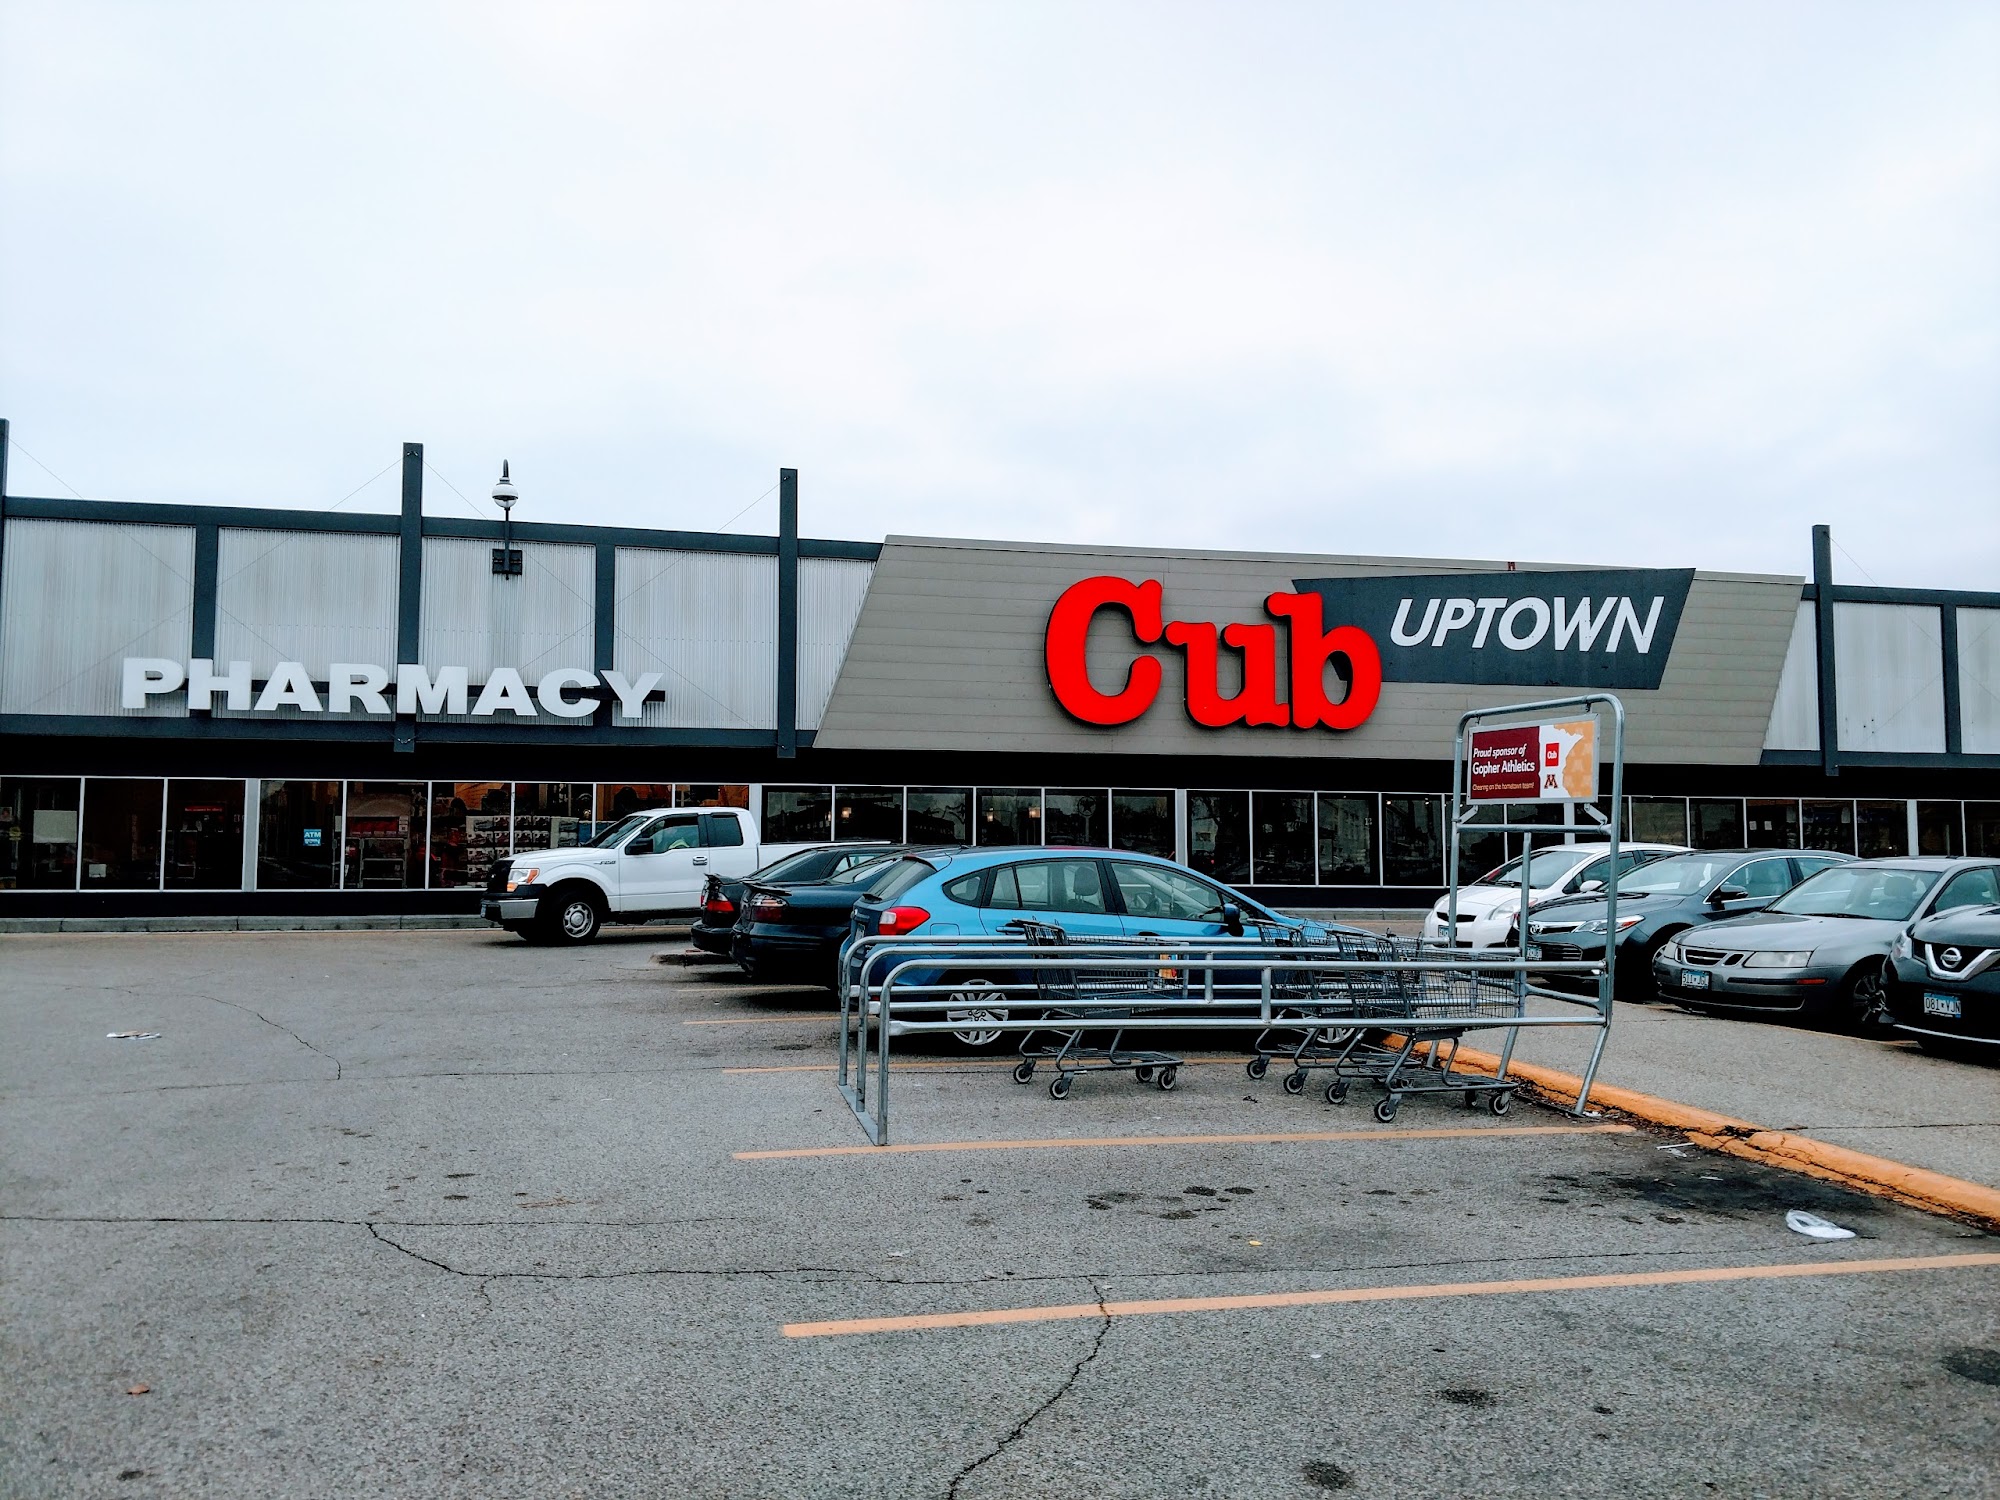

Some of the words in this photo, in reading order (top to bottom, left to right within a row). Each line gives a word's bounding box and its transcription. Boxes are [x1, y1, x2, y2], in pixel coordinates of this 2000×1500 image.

[1045, 575, 1381, 729] Cub
[1389, 595, 1664, 653] UPTOWN
[122, 657, 665, 718] PHARMACY
[1472, 761, 1501, 777] Gopher
[1501, 759, 1535, 773] Athletics
[1473, 747, 1493, 758] Proud
[1492, 747, 1518, 759] sponsor
[1518, 743, 1527, 757] of
